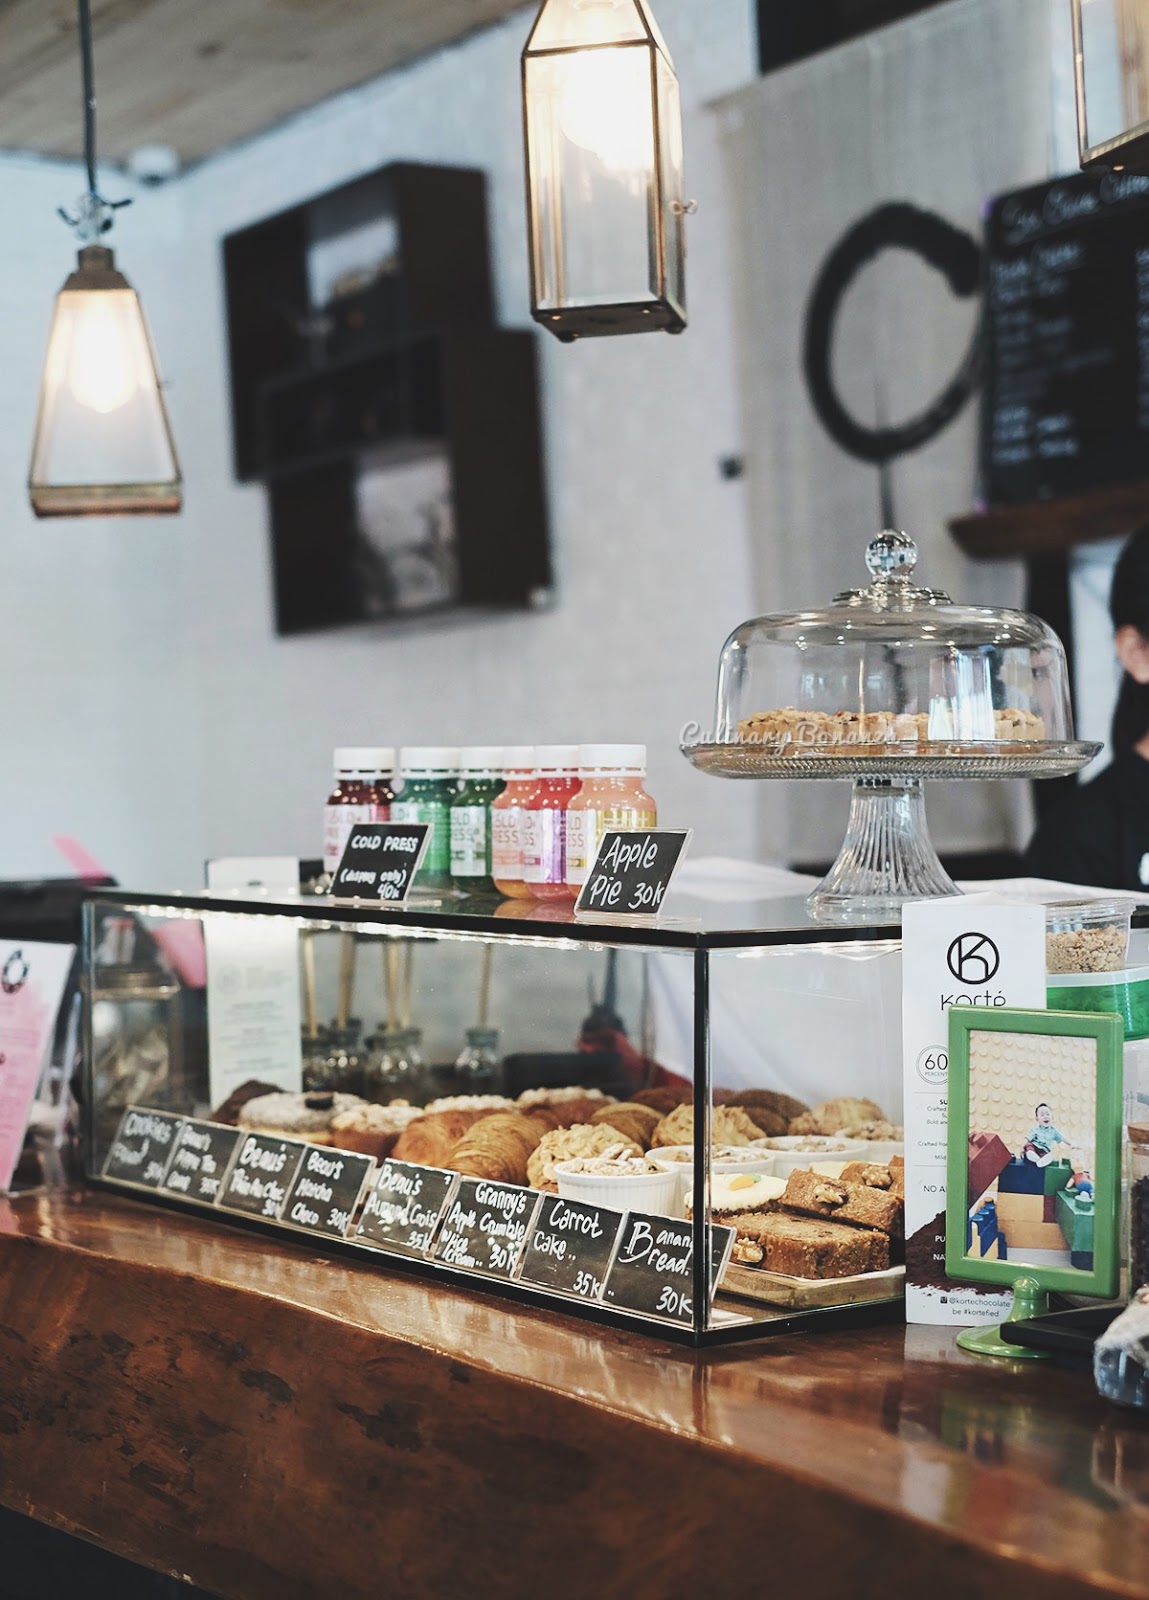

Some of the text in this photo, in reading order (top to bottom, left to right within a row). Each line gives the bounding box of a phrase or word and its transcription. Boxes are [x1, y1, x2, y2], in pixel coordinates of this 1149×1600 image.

[351, 835, 419, 853] COLD PRESS
[602, 835, 658, 873] Apple
[589, 874, 622, 907] Pie
[924, 1053, 949, 1070] 60
[240, 1137, 287, 1172] Beau's
[378, 1164, 423, 1196] Beau's
[923, 1185, 937, 1193] NO
[475, 1182, 527, 1220] Granny's
[448, 1201, 477, 1235] Apple
[549, 1200, 603, 1239] Carrot
[618, 1221, 694, 1264] Banan
[949, 1296, 1011, 1309] @kortechocolate
[963, 1309, 1000, 1319] #kortefied
